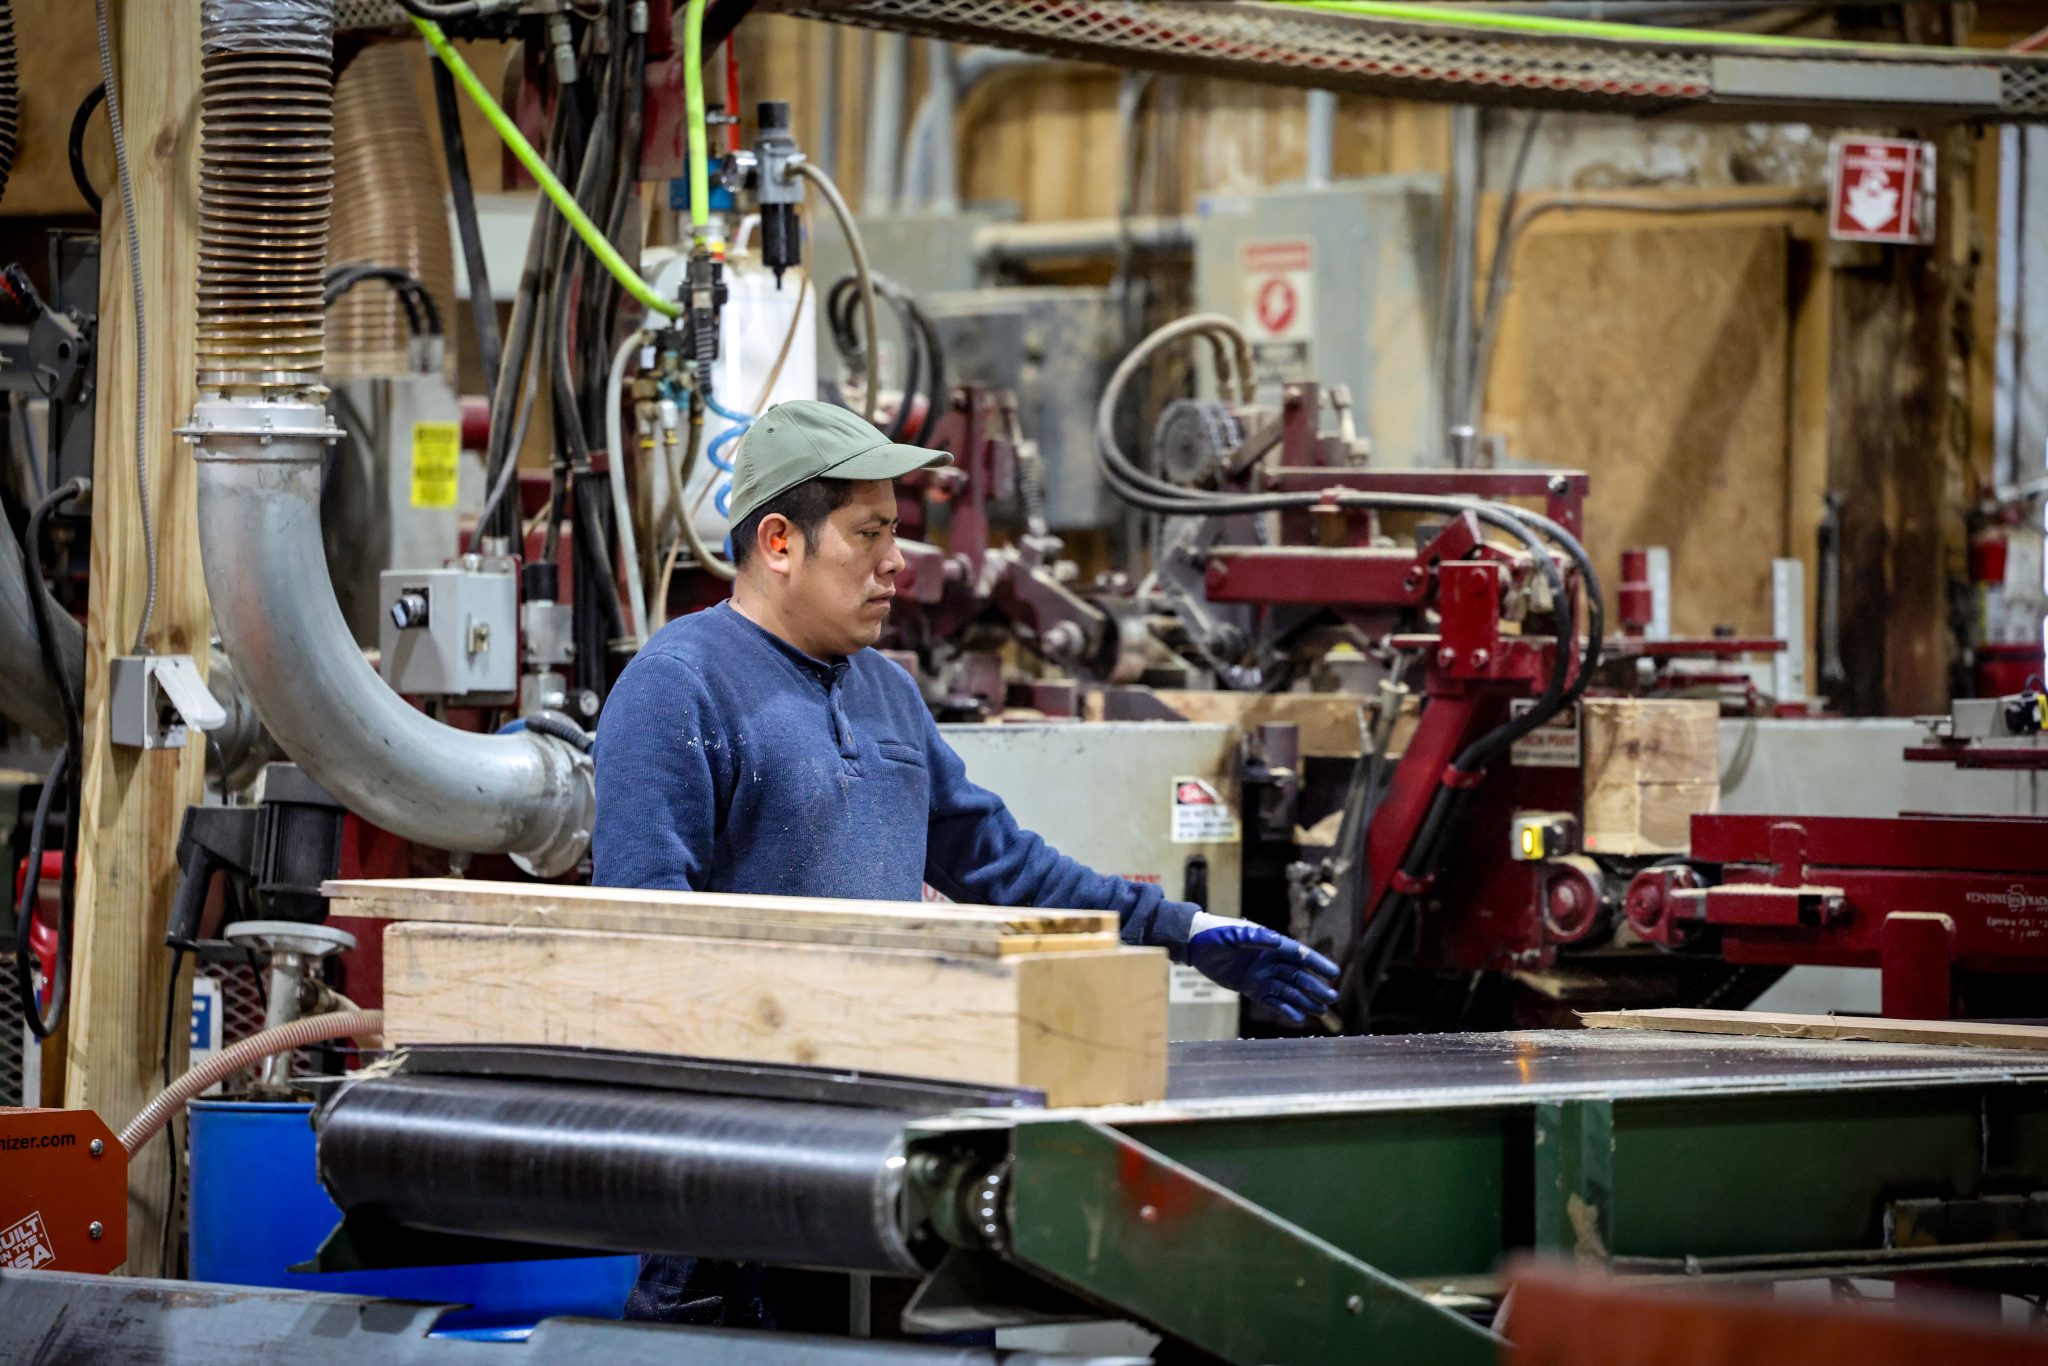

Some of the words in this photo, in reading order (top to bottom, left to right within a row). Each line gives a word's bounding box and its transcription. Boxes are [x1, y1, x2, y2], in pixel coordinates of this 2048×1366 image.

[0, 1216, 38, 1252] UILT
[12, 1235, 38, 1254] THE
[8, 1243, 52, 1270] SA
